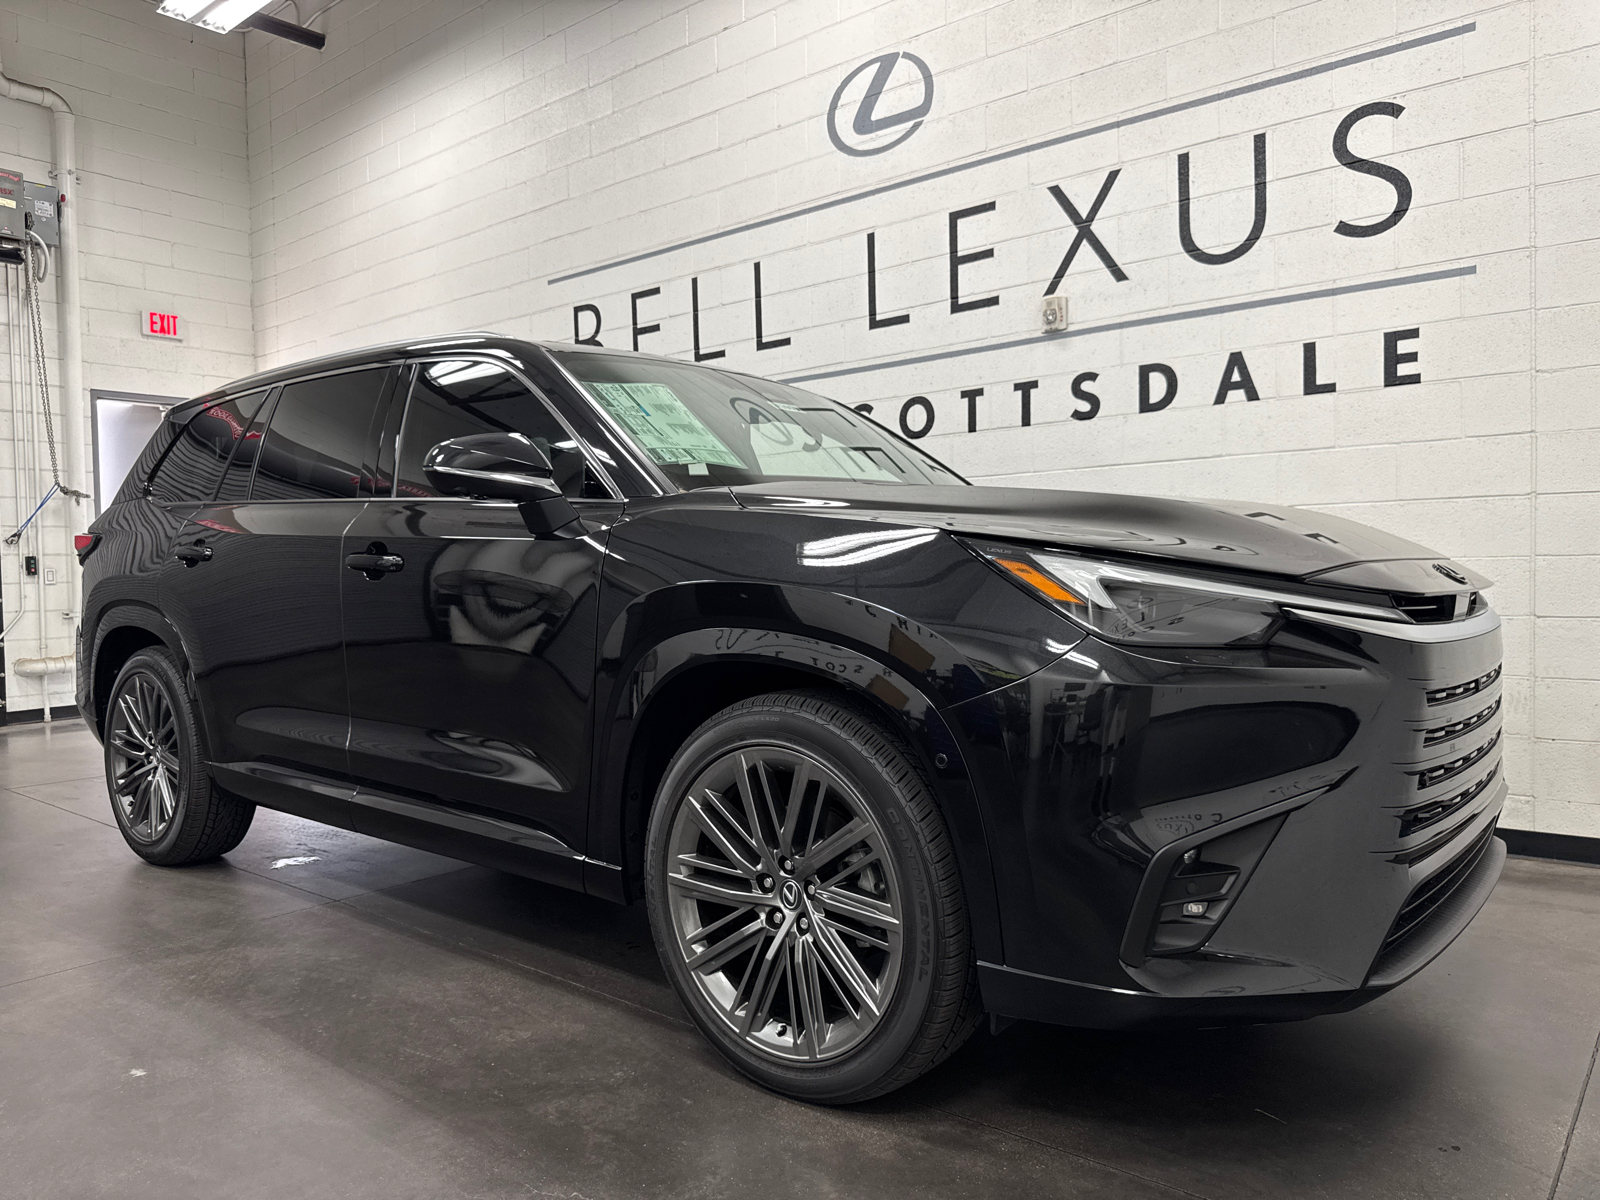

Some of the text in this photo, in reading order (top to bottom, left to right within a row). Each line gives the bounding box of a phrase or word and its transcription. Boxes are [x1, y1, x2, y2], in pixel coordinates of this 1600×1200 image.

[867, 101, 1413, 330] LEXUS
[149, 311, 178, 336] EXIT
[853, 327, 1422, 439] OTTSDALE
[986, 547, 1012, 555] LEXUS
[886, 807, 931, 982] CONTINENTAL
